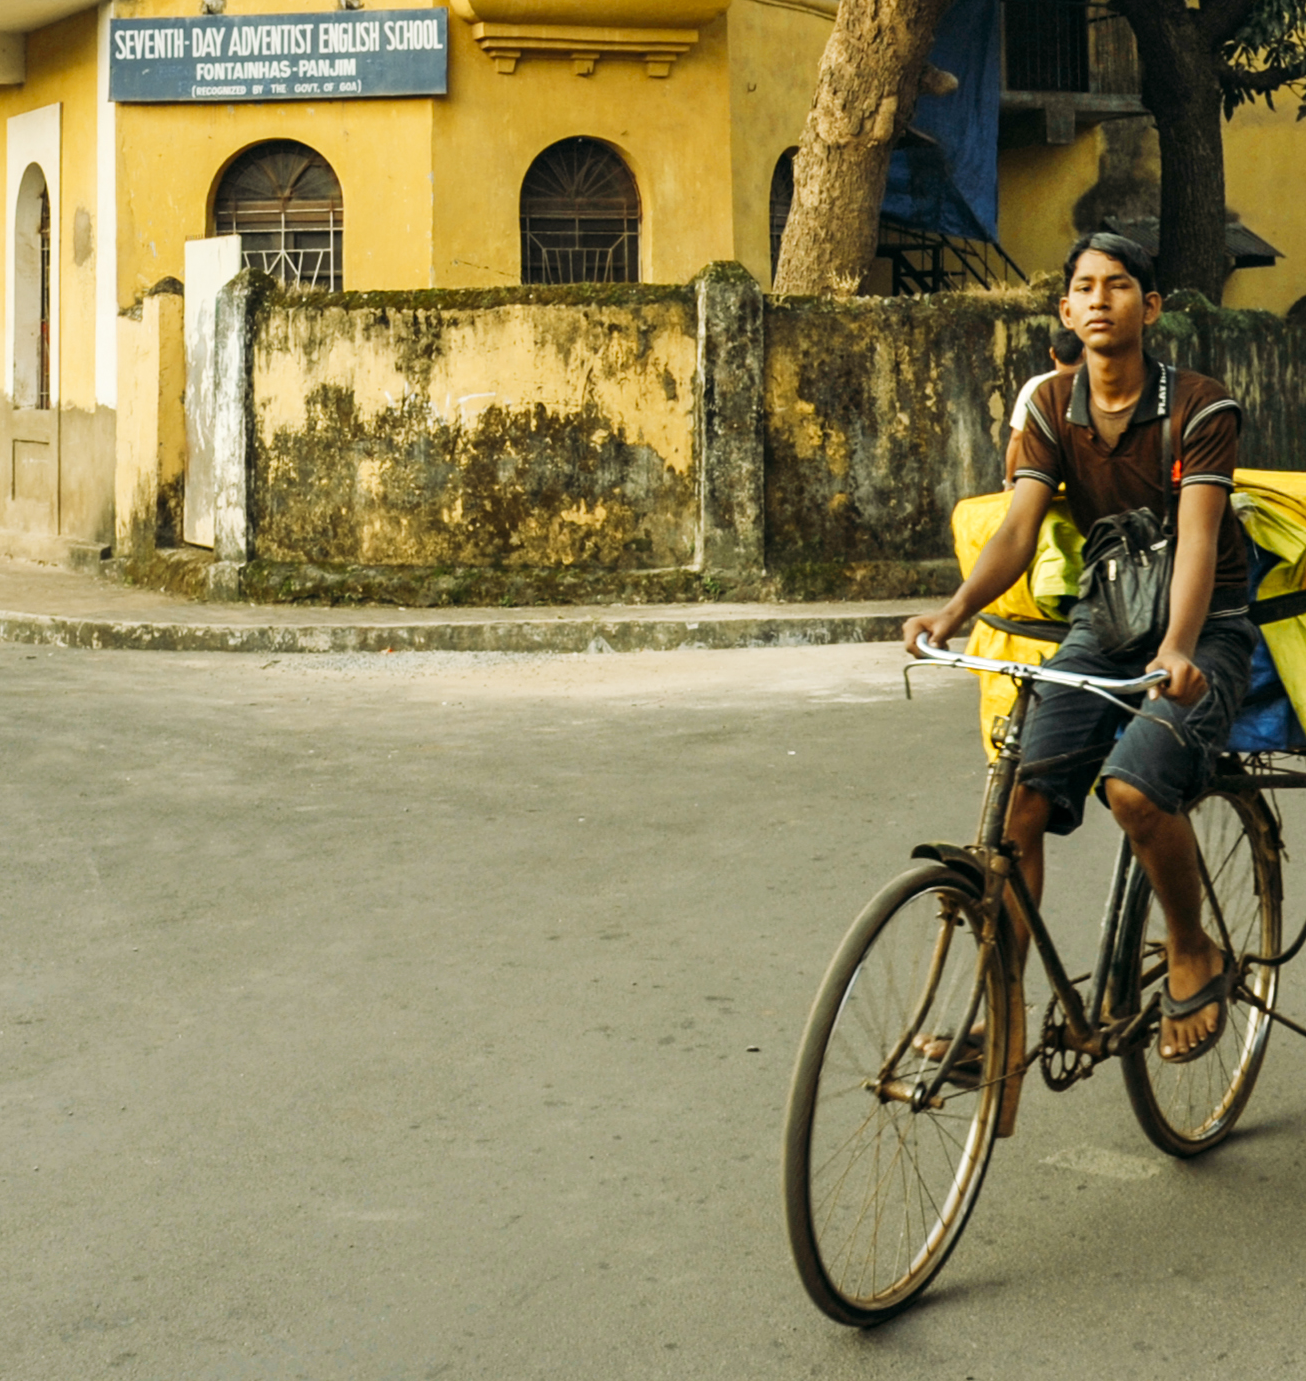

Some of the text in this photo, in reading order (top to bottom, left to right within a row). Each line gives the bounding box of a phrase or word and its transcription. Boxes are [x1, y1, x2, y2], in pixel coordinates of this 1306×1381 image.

[228, 24, 314, 56] ADVENTIST
[319, 21, 380, 53] ENGLISH
[383, 19, 443, 51] SCHOOL
[196, 58, 356, 80] FONTAINHAS-PANJIM
[191, 84, 247, 98] (RECOGNIZED
[252, 84, 263, 95] BY
[271, 83, 286, 94] THE
[324, 82, 333, 92] OF
[339, 79, 362, 93] GOA)
